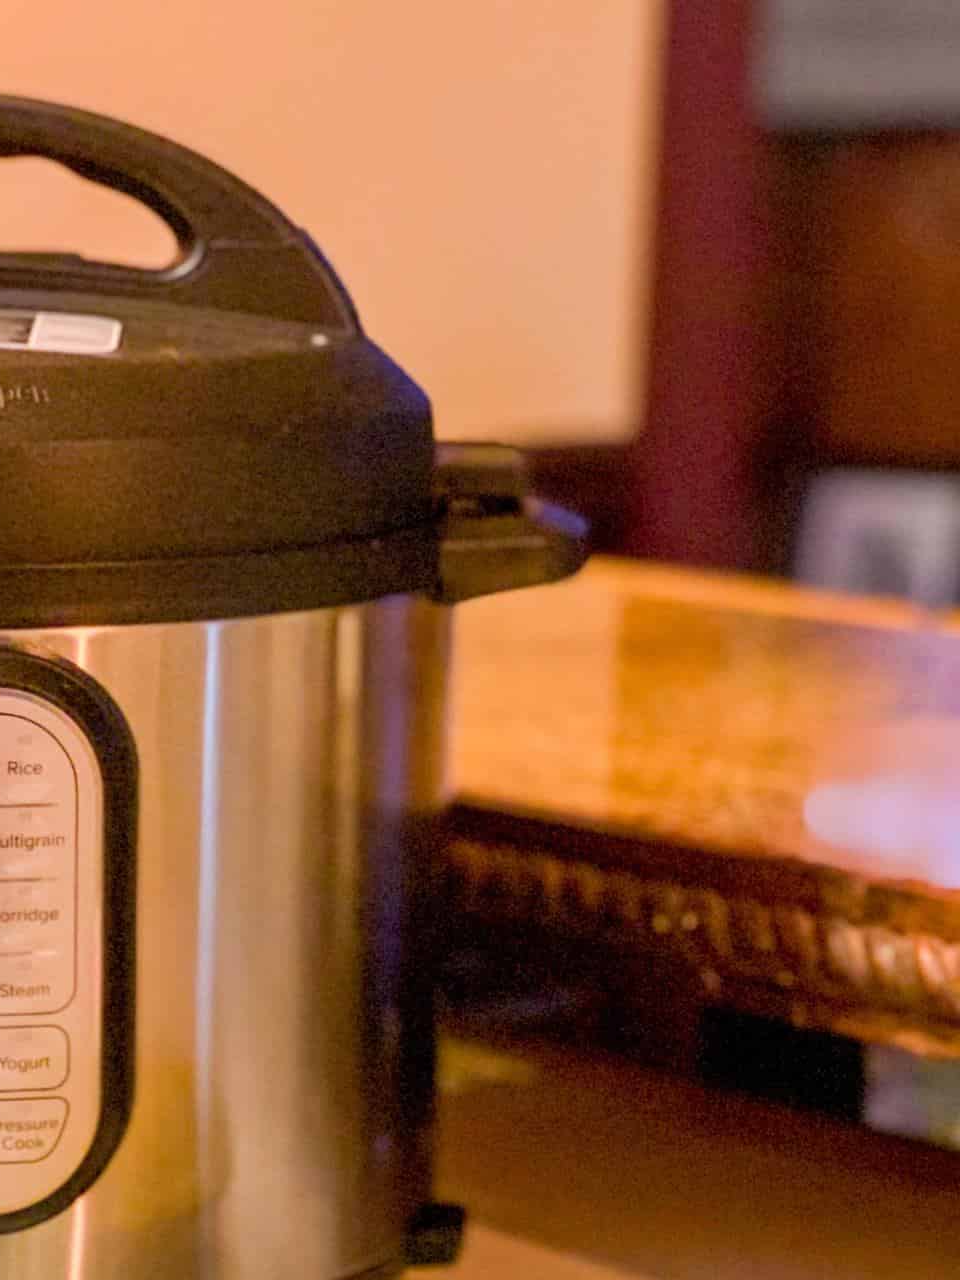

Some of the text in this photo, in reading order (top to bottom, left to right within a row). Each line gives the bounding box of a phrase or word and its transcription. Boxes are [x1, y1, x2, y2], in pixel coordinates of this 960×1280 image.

[7, 761, 43, 775] Rice
[0, 982, 51, 999] Steam
[2, 1134, 45, 1152] Cook
